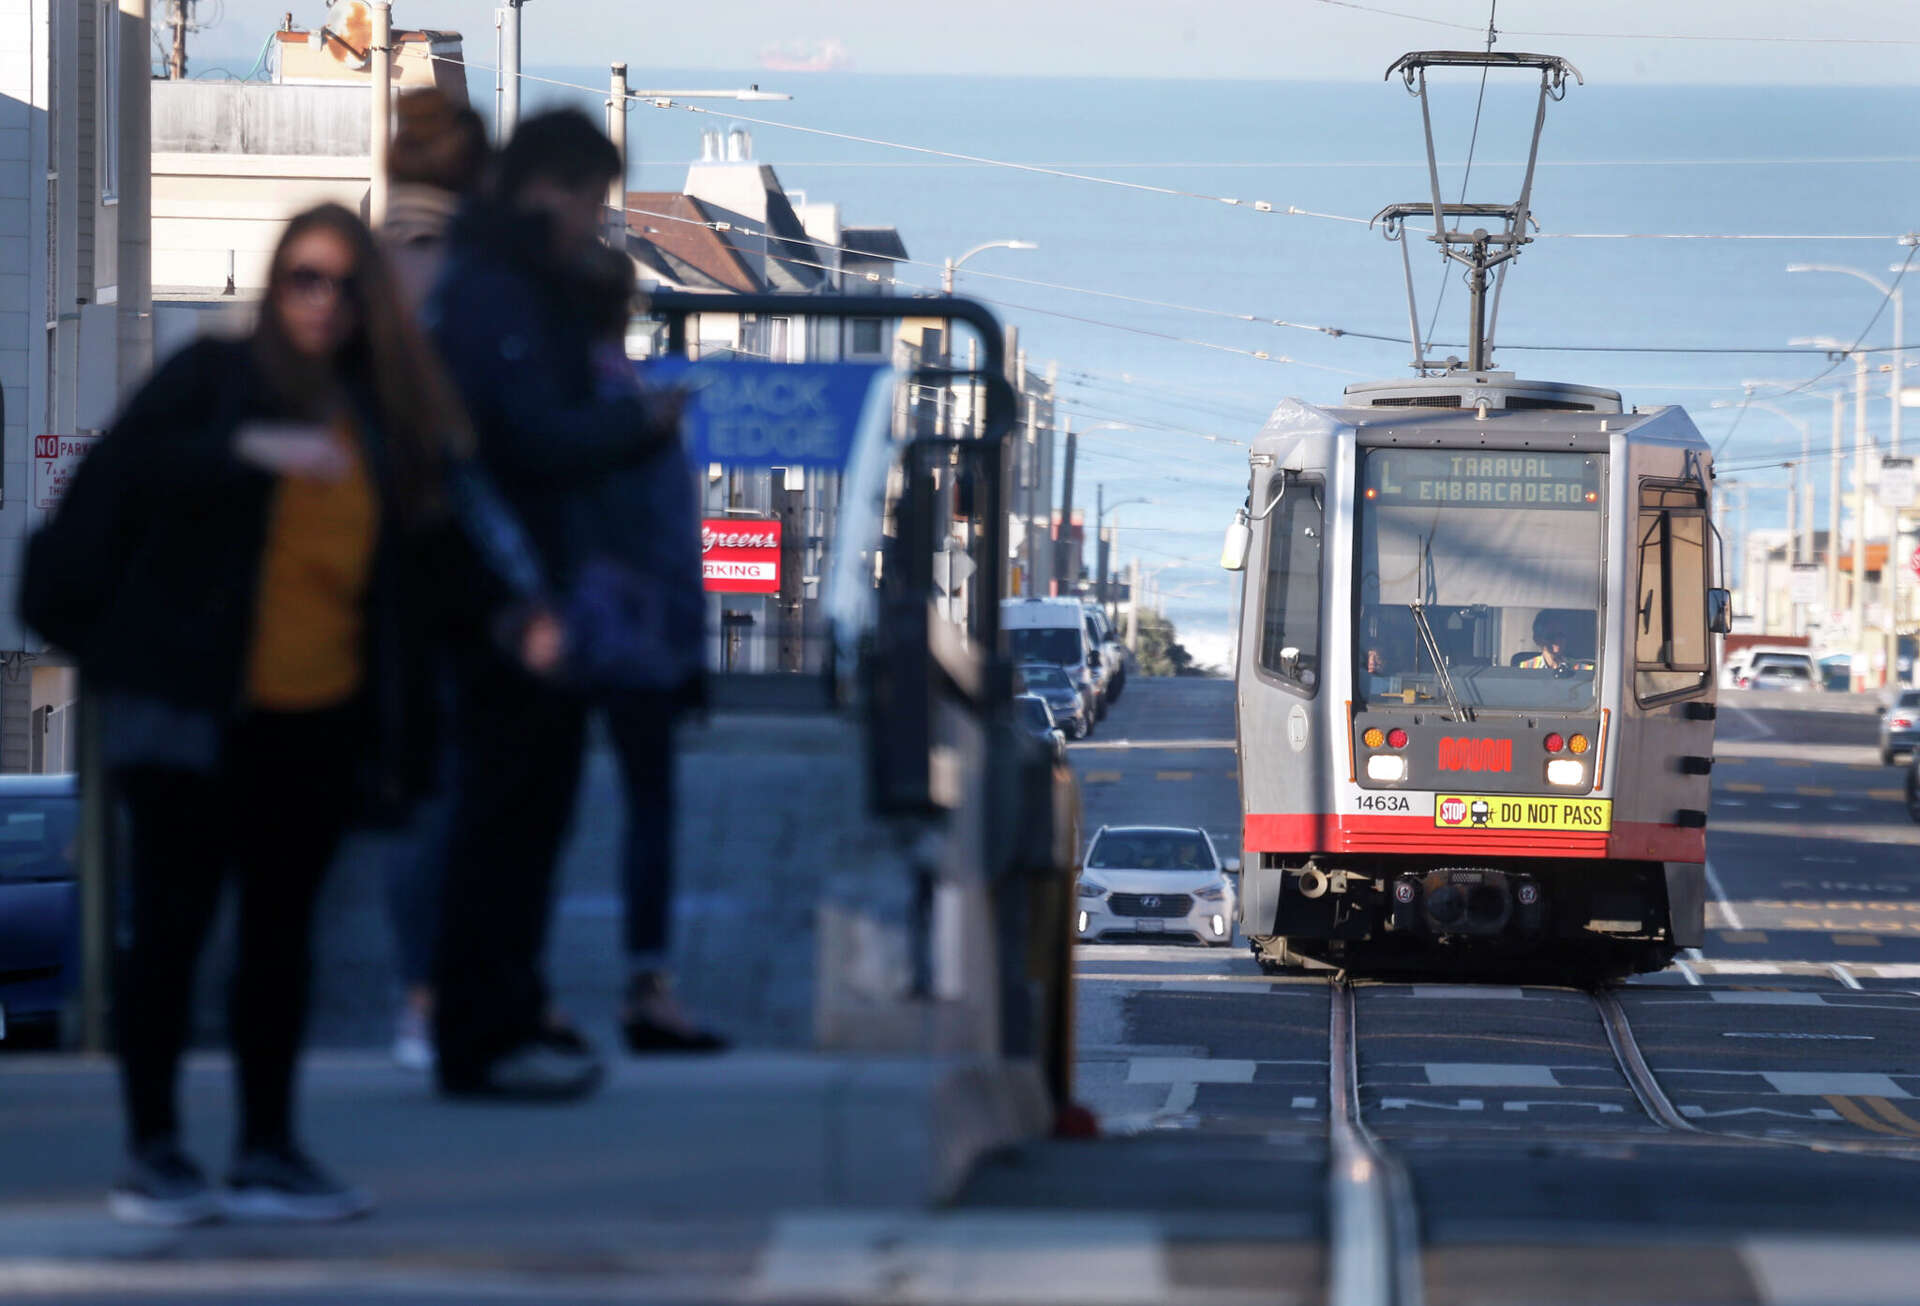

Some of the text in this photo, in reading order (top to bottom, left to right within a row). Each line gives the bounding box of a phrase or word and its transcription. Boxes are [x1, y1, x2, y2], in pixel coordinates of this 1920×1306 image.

[37, 438, 57, 456] NO
[1381, 460, 1401, 494] L
[1450, 457, 1553, 479] TARAVAL
[1419, 481, 1583, 503] EMBARCADERO
[1355, 796, 1410, 812] 1463A
[1442, 804, 1467, 820] STOP
[1501, 803, 1603, 826] DO NOT PASS
